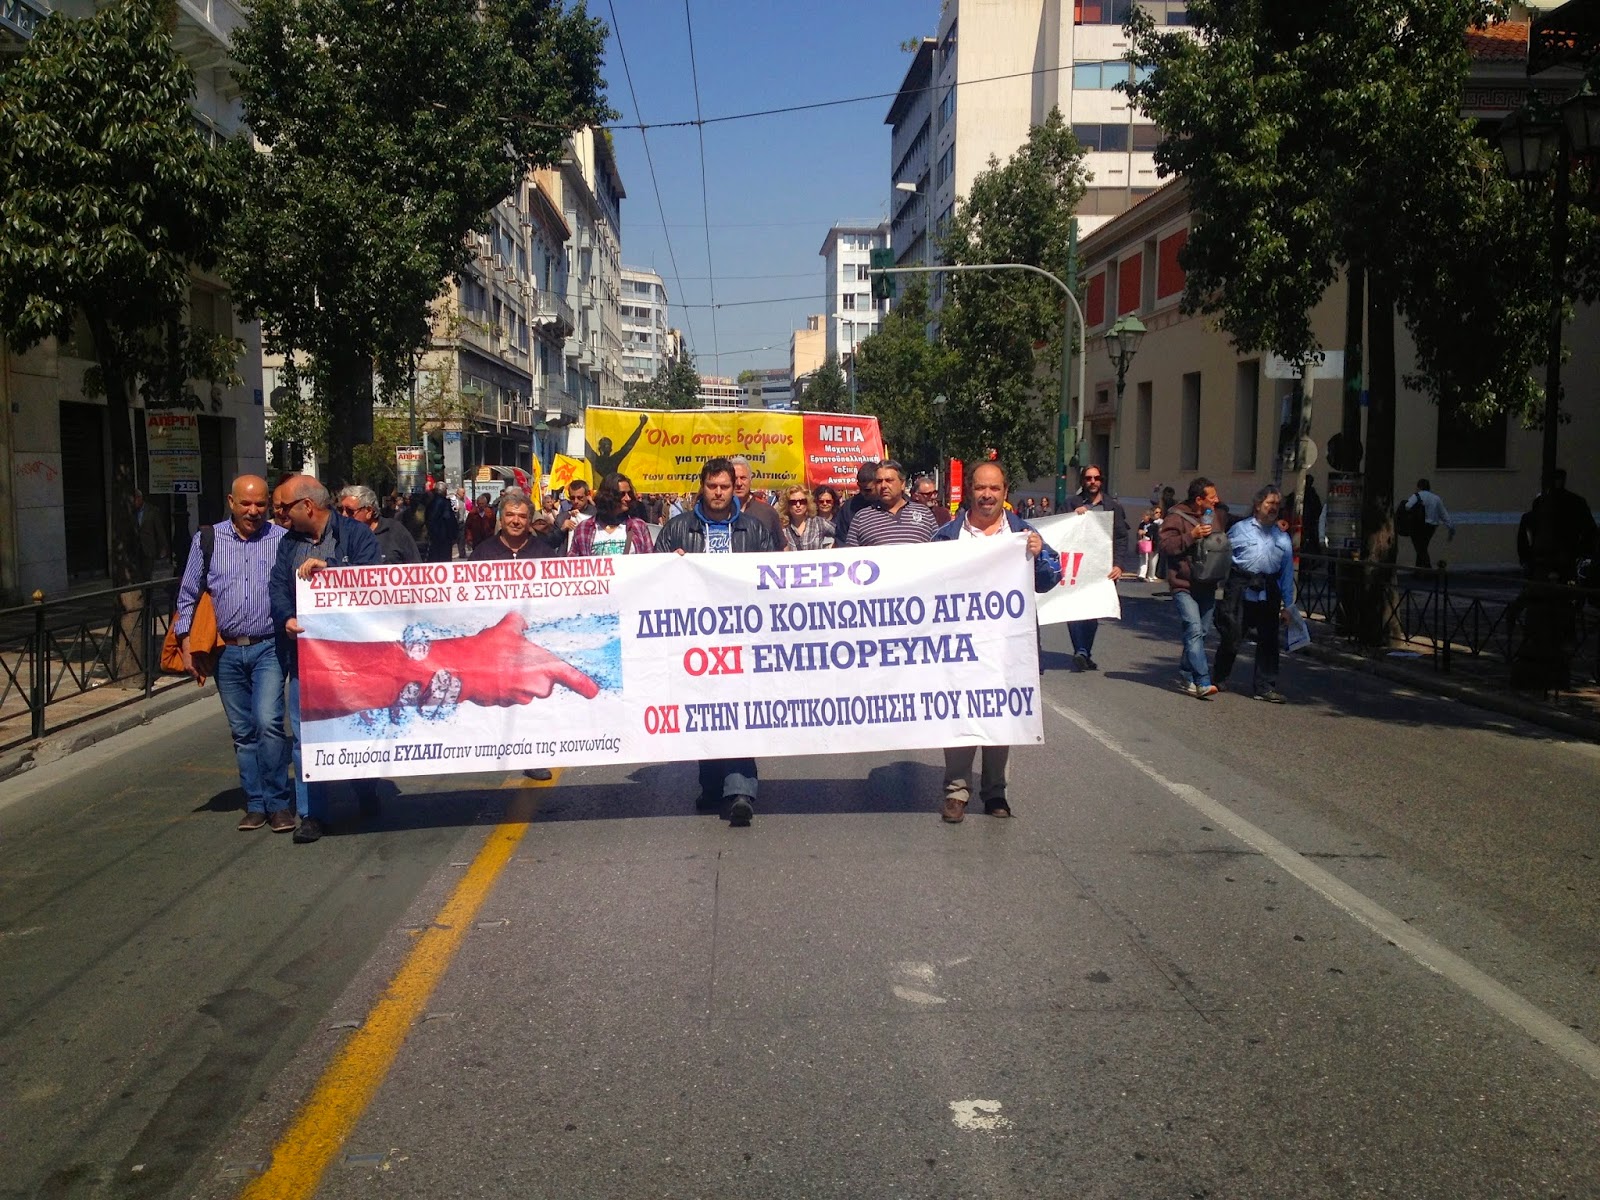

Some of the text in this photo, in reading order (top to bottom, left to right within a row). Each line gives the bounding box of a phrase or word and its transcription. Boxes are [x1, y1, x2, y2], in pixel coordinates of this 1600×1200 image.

[645, 428, 793, 451] Όλοι στους δρόμους
[819, 424, 864, 442] ΜΕΤΑ
[675, 455, 692, 465] για
[824, 445, 861, 454] Μαχητική
[642, 473, 665, 481] των
[310, 557, 615, 589] ΣΥΜΜΕΤΟΧΙΚΟ ΕΝΩΤΙΚΟ ΚΙΝΗΜΑ
[756, 559, 881, 590] ΝΕΡΟ
[314, 579, 610, 608] ΕΡΓΑΖΟΜΕΝΩΝ & ΣΥΝΤΑΞΙΟΥΧΩΝ
[636, 589, 1026, 639] ΔΗΜΟΣΙΟ ΚΟΙΝΩΝΙΚΟ ΑΓΑΘΟ
[683, 633, 979, 677] ΟΧΙ ΕΜΠΟΡΕΥΜΑ
[644, 686, 1034, 735] ΟΧΙ ΣΤΗΝ ΙΔΙΩΤΙΚΟΠΟΙΗΣΗ ΤΟΥ ΝΕΡΟΥ
[314, 749, 335, 767] Για
[338, 745, 391, 766] δημόσια
[474, 739, 532, 760] υπηρεσία
[536, 741, 556, 757] της
[559, 736, 620, 754] κοινωνίας
